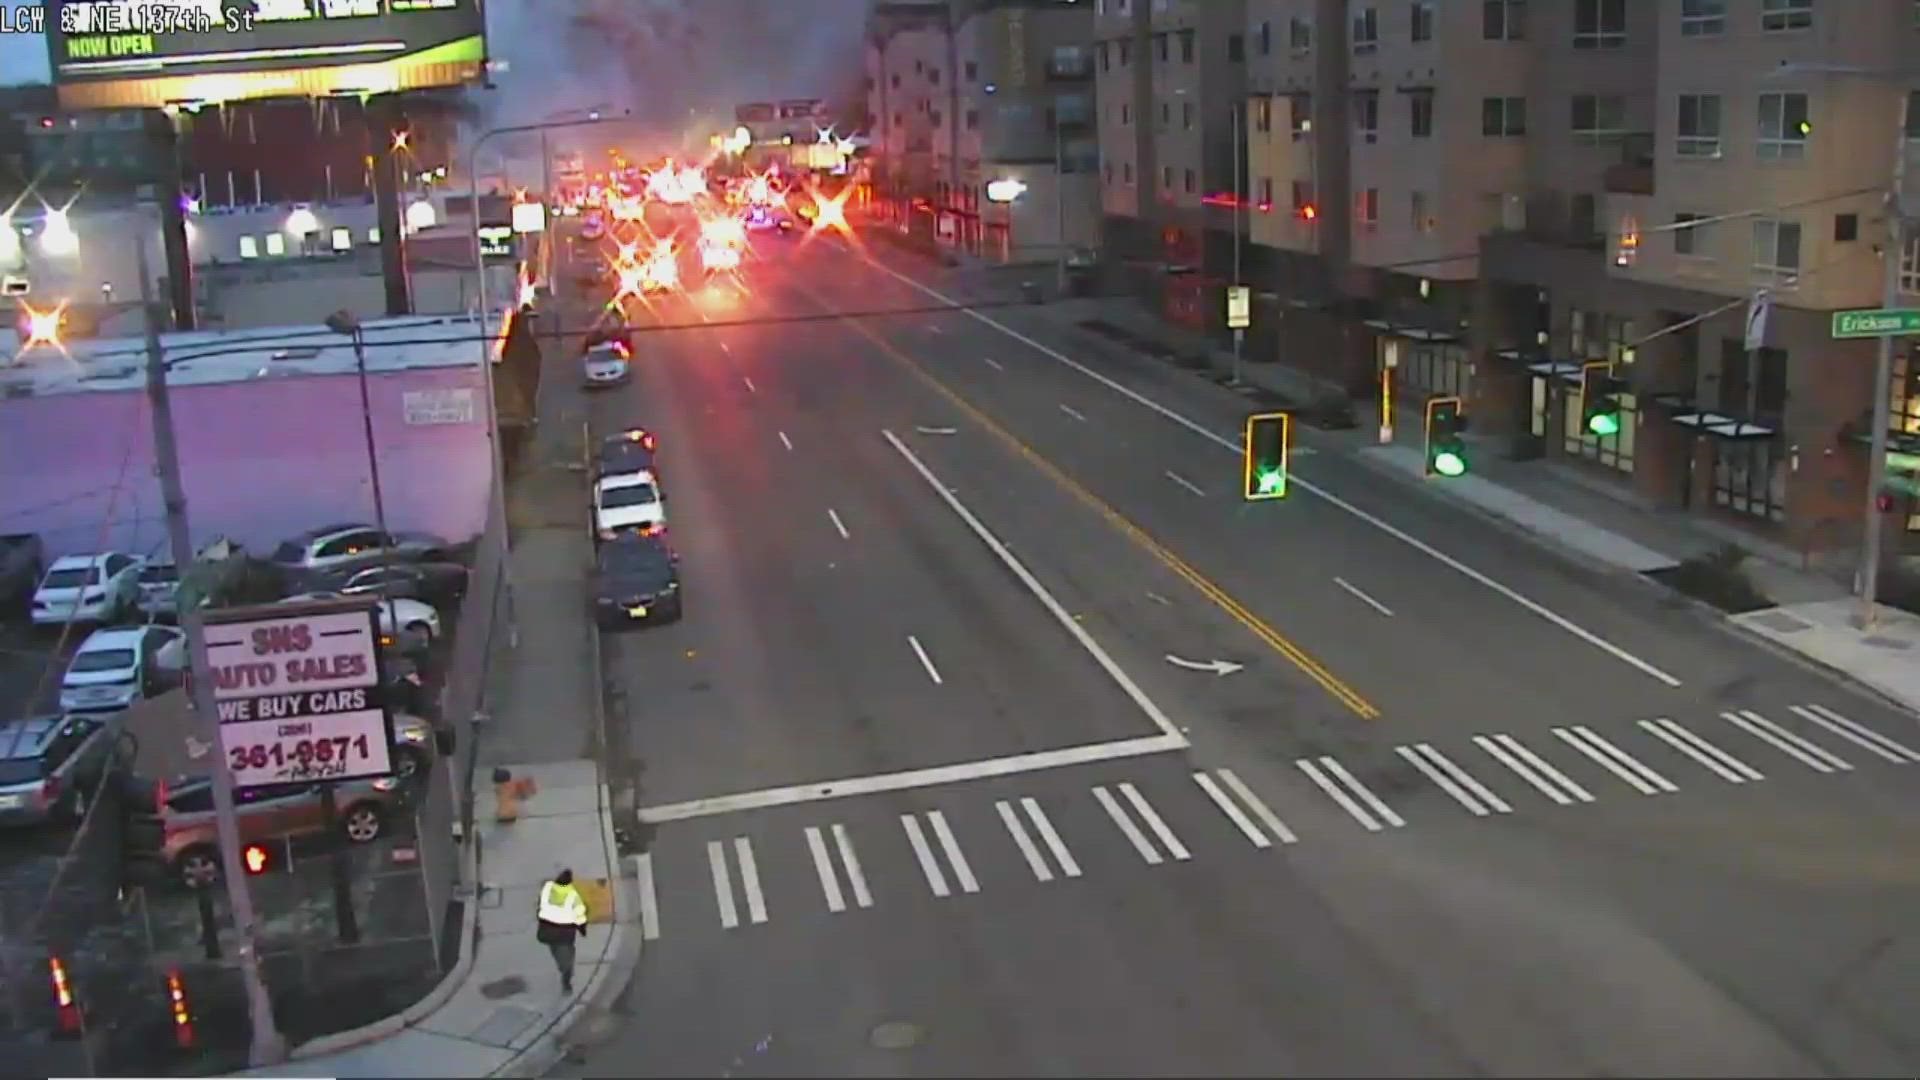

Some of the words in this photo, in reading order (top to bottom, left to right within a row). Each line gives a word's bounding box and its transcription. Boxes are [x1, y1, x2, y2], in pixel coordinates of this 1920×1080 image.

[68, 37, 105, 58] NOW
[110, 34, 153, 55] OPEN
[285, 653, 367, 683] SALES
[217, 700, 250, 722] WE
[257, 696, 303, 717] BUY
[309, 688, 367, 711] CARS
